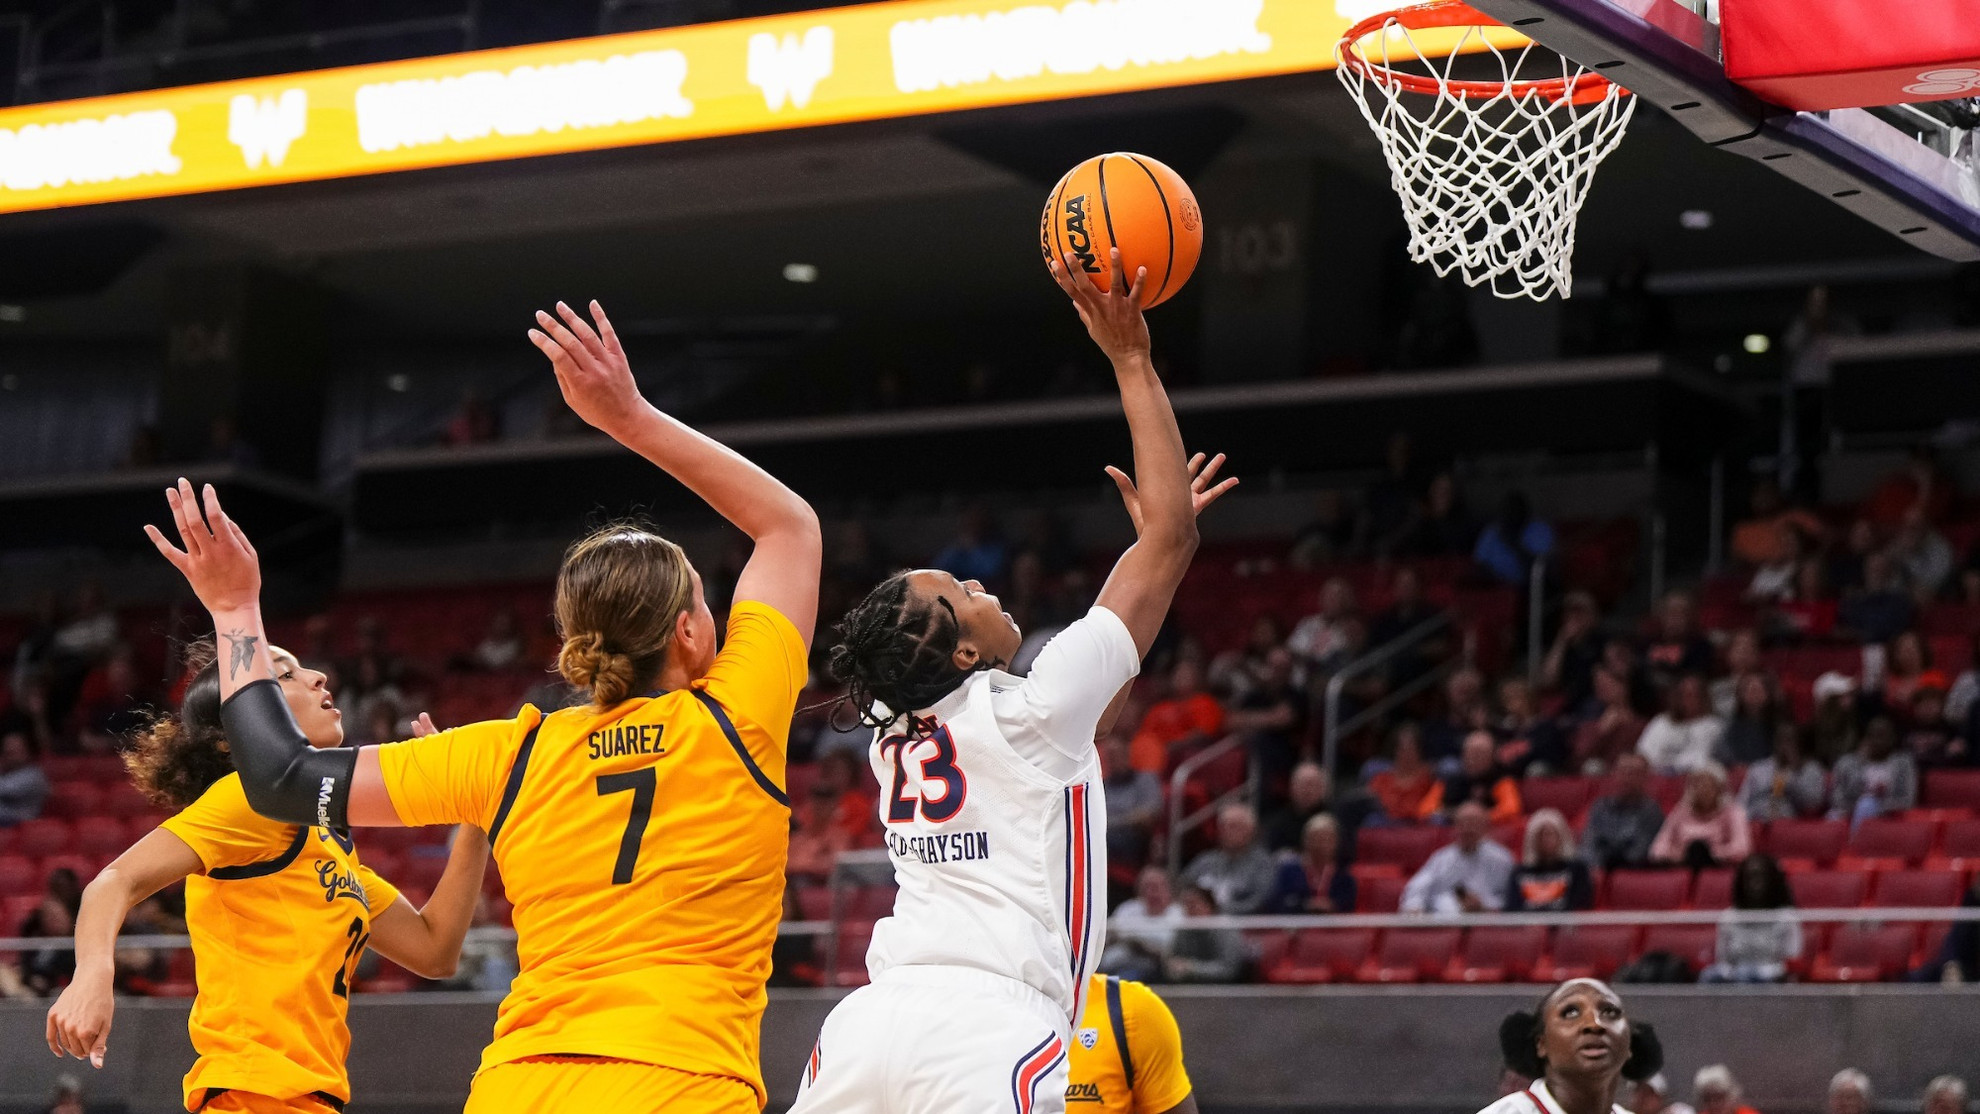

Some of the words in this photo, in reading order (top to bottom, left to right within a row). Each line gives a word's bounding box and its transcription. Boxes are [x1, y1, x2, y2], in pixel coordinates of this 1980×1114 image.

[1065, 194, 1102, 274] NCAA
[588, 719, 665, 760] SUÁREZ
[880, 723, 968, 824] 23
[317, 784, 334, 827] Muelle
[595, 766, 657, 885] 7
[332, 916, 370, 1000] 2
